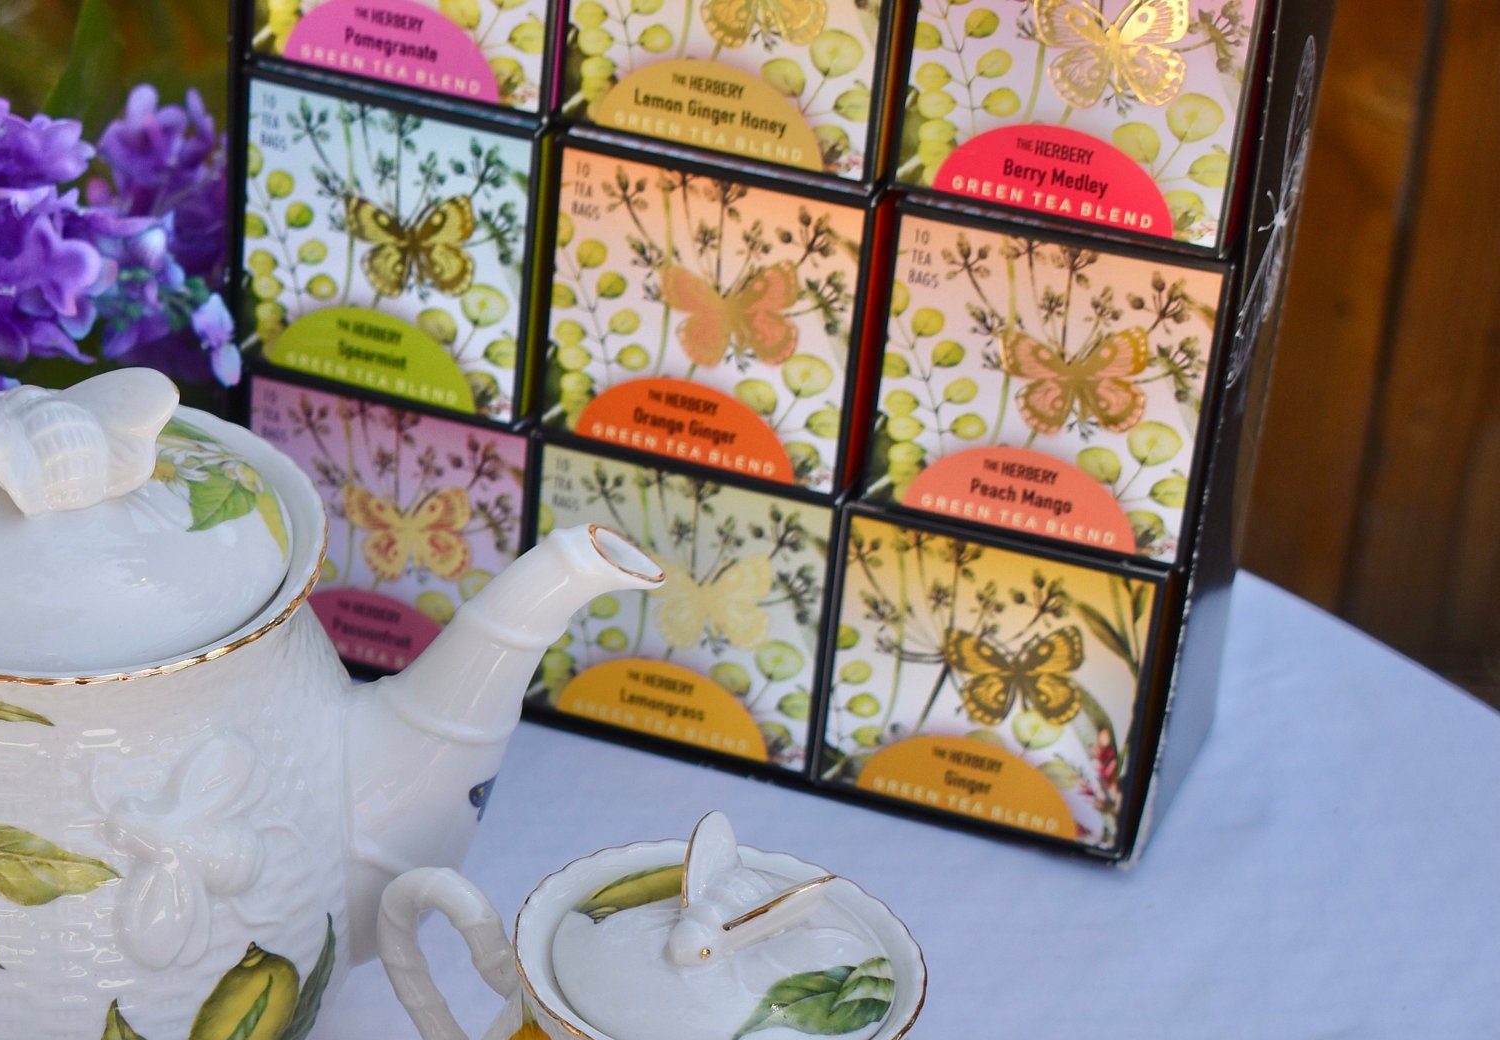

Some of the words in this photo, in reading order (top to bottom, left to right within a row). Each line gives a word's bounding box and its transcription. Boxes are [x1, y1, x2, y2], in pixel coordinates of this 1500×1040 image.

[371, 8, 424, 33] HERBERY
[344, 26, 437, 63] Pomegranate
[301, 44, 364, 70] GREEN
[373, 60, 407, 79] TEA
[415, 70, 480, 95] BLEND
[689, 76, 745, 99] HERBERY
[634, 88, 682, 115] Lemon
[688, 99, 736, 126] Ginger
[741, 110, 787, 139] Honey
[614, 110, 680, 138] GREEN
[690, 127, 726, 147] TEA
[736, 137, 802, 163] BLEND
[1017, 137, 1032, 150] THE
[1035, 140, 1094, 165] HERBERY
[1003, 159, 1046, 186] Berry
[1051, 169, 1108, 198] Medley
[952, 175, 1023, 203] GREEN
[1033, 192, 1071, 213] TEA
[1081, 202, 1153, 229] BLEND
[916, 228, 930, 245] 10
[913, 249, 932, 265] TEA
[665, 391, 718, 416] HERBERY
[634, 407, 684, 434] Orange
[689, 419, 737, 445] Ginger
[592, 422, 658, 448] GREEN
[666, 438, 701, 459] TEA
[709, 449, 776, 476] BLEND
[1001, 462, 1059, 485] HERBERY
[970, 478, 1016, 502] Peach
[1022, 490, 1072, 516] Mango
[921, 494, 990, 520] GREEN
[1000, 510, 1037, 529] TEA
[1046, 521, 1116, 545] BLEND
